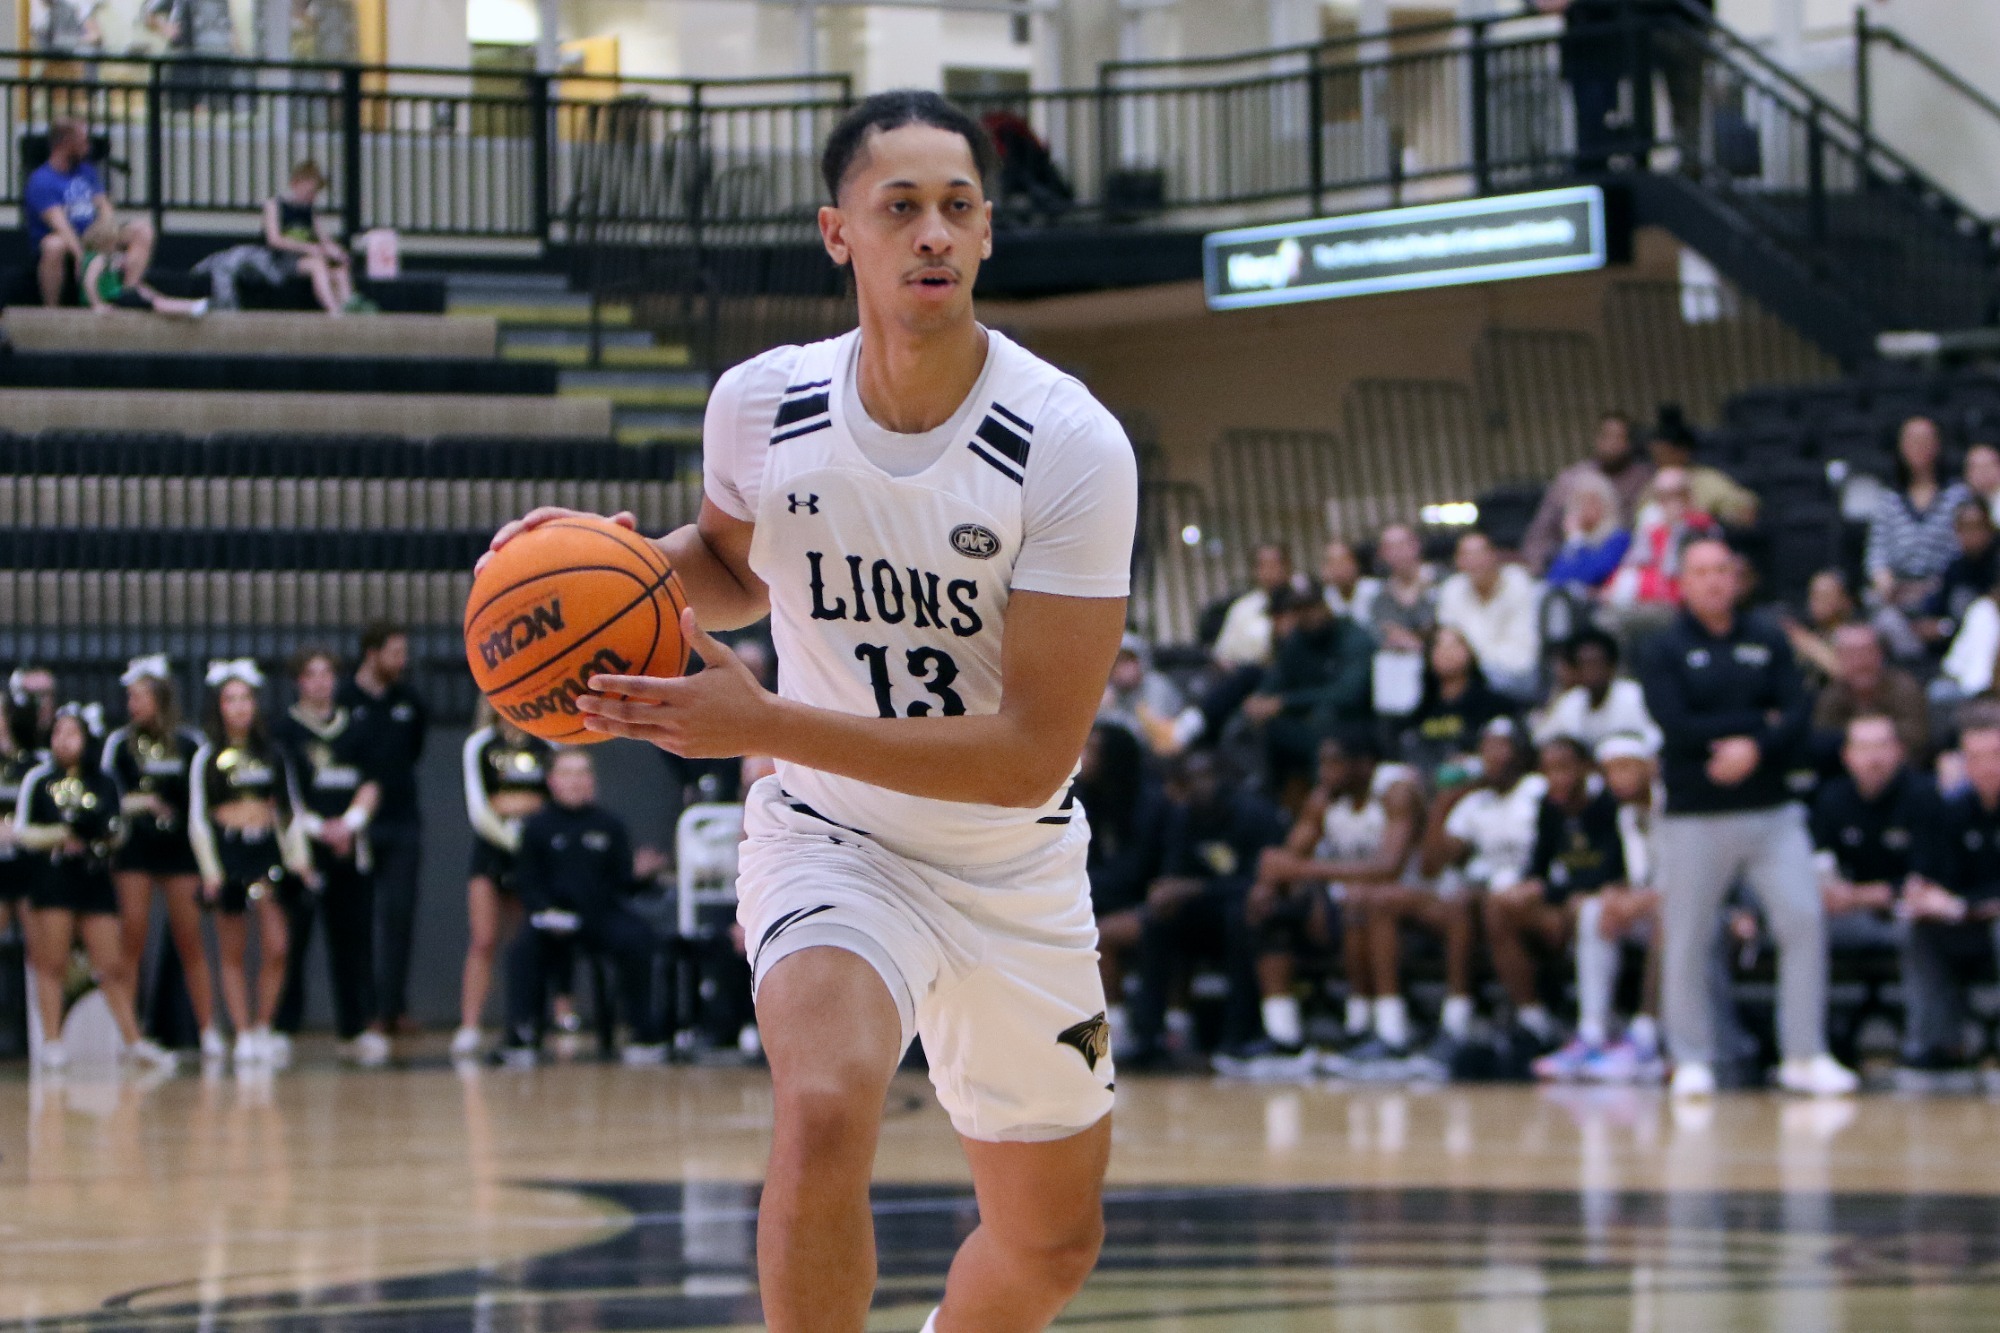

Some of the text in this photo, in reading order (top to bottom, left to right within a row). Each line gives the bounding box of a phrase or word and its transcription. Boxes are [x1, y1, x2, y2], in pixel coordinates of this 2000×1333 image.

[958, 531, 991, 553] OVC
[806, 551, 983, 637] LIONS
[480, 598, 565, 671] NCAA
[854, 643, 966, 718] 13
